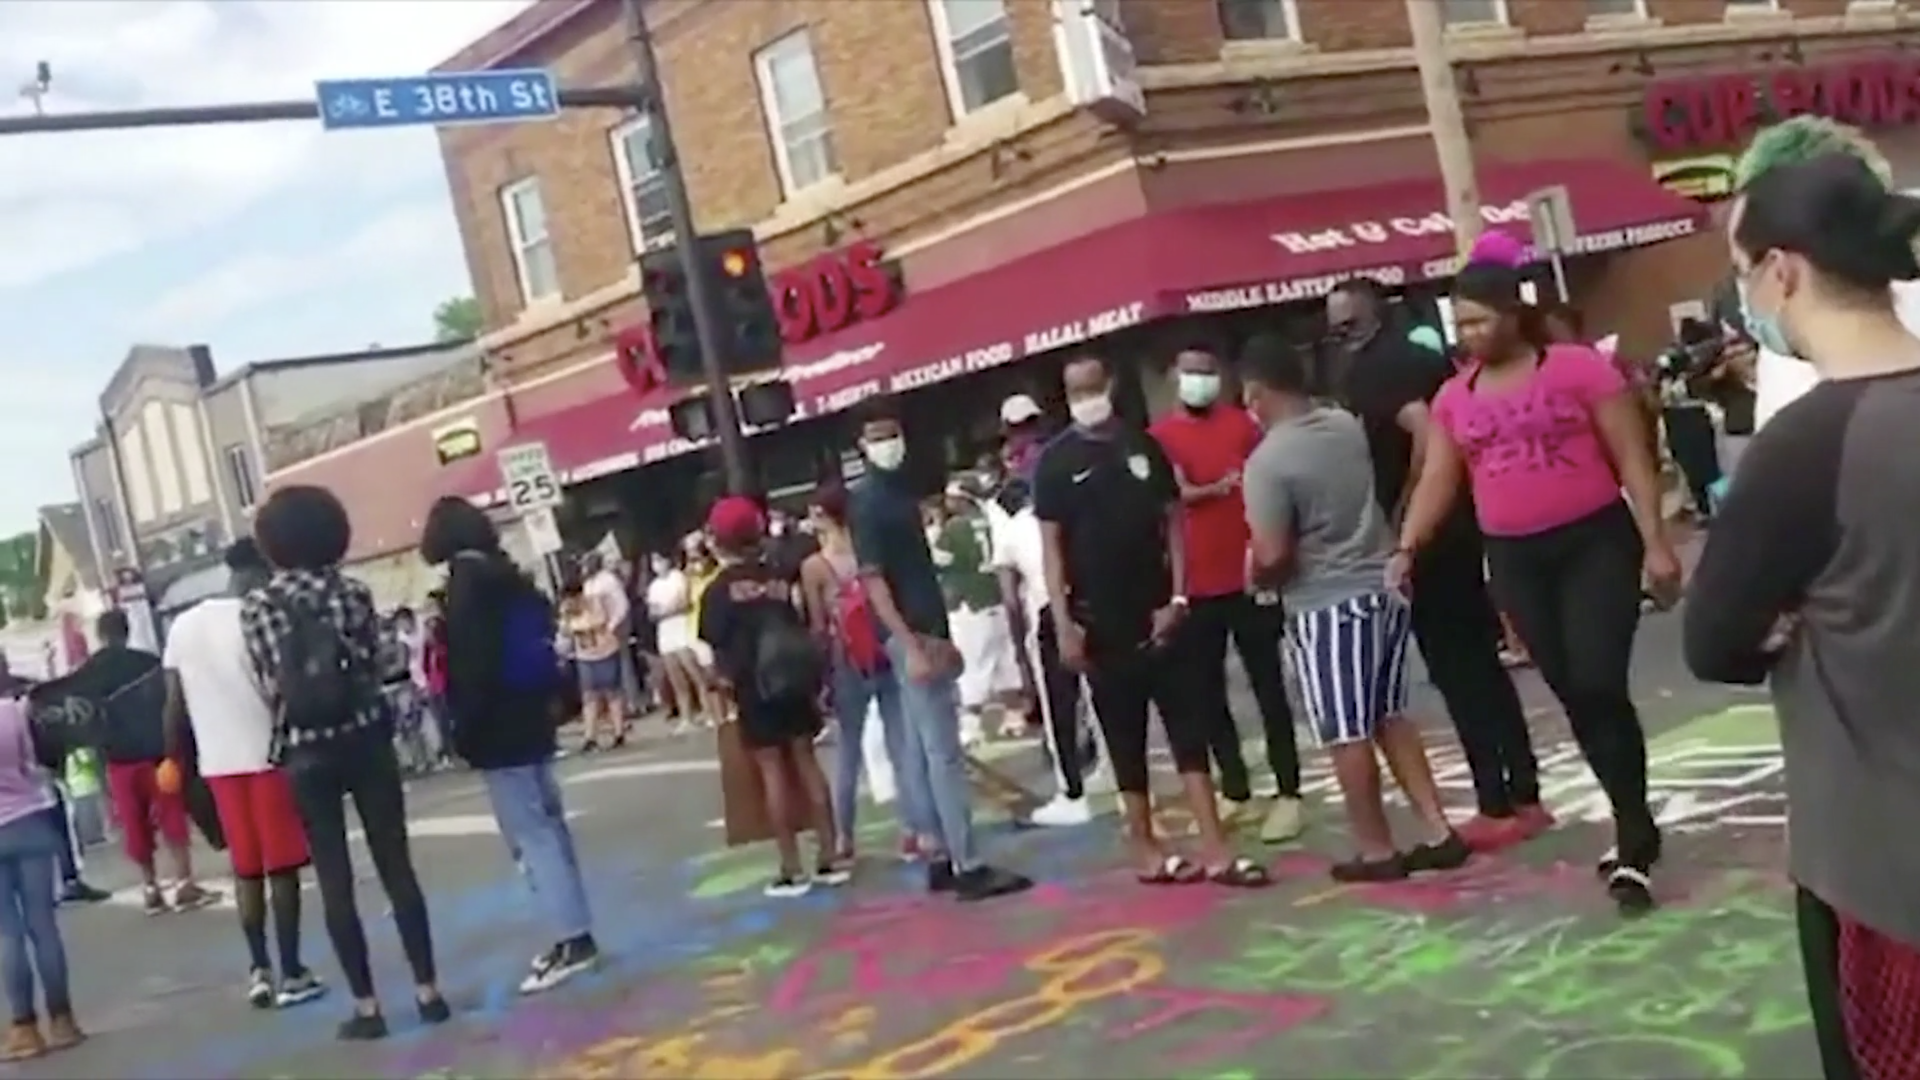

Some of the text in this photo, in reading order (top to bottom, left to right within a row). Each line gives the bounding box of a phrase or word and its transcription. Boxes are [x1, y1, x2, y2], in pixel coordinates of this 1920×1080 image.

[374, 80, 549, 118] E 38th St
[1645, 70, 1757, 150] CUP
[1270, 228, 1356, 254] Hot
[1187, 285, 1264, 312] MIDDLE
[889, 355, 963, 392] MEXICAN
[965, 342, 1014, 371] FOOD
[1023, 320, 1084, 355] HALAL
[1087, 301, 1144, 338] MEAT
[511, 474, 555, 506] 25
